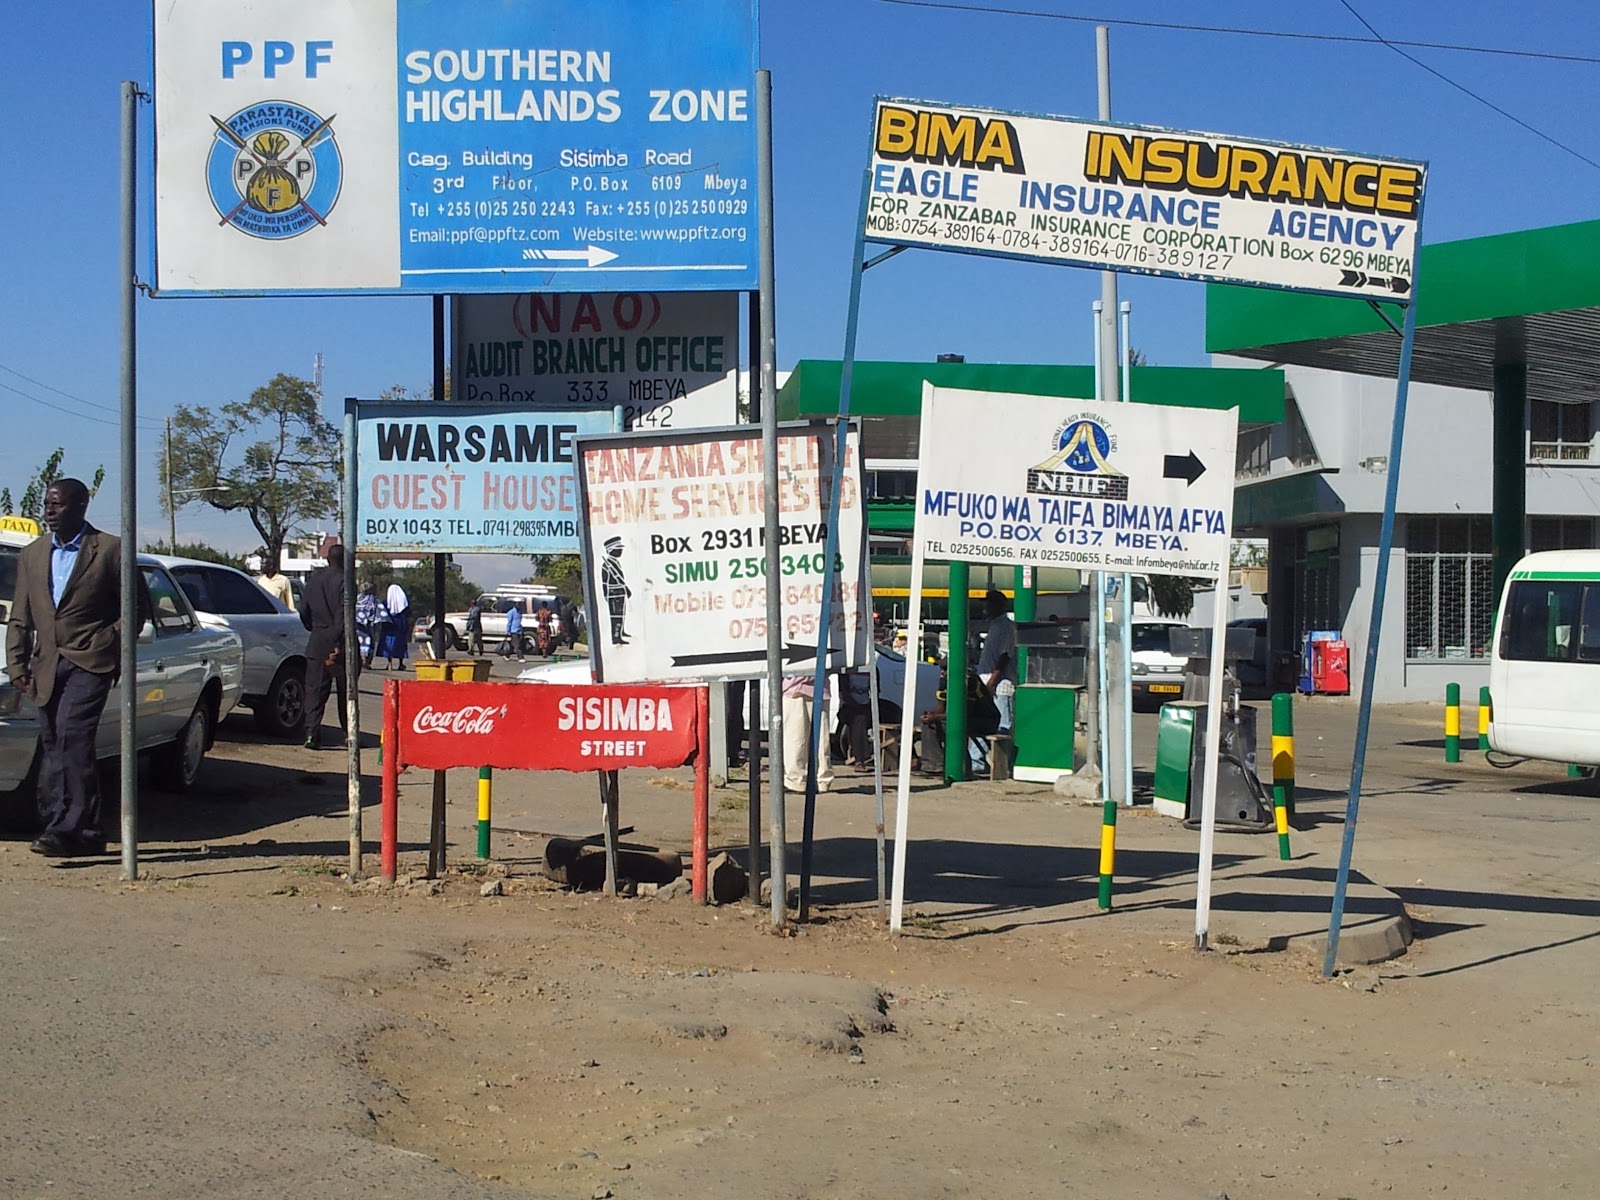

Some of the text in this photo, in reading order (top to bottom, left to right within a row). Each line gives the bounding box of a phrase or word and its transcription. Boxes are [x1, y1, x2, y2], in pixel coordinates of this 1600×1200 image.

[221, 40, 334, 79] PPF
[405, 49, 611, 83] SOUTHERN
[228, 106, 318, 131] PARASTATAL
[406, 89, 748, 123] HIGHLANDS ZONE
[237, 117, 311, 136] PENSIONS FUND
[462, 150, 534, 170] Building
[560, 149, 629, 168] Sisimba
[646, 148, 692, 166] Road
[876, 104, 1420, 220] BIMA INSURANCE
[433, 175, 465, 194] 3rd
[651, 175, 682, 191] 6109
[704, 174, 748, 196] Mbeya
[410, 202, 430, 217] Tel
[541, 200, 576, 217] 2243
[873, 163, 1405, 251] EAGLE INSURANCE AGENCY
[870, 196, 1412, 277] FOR ZANZABAR INSURANCE CORPORATION Box 6296 MBEYA
[465, 335, 724, 379] AUDIT BRANCH OFFICE
[567, 380, 608, 402] 333
[629, 377, 688, 401] MBEYA
[376, 422, 578, 463] WARSAME
[584, 442, 726, 485] TANZANIA
[730, 435, 825, 475] SHELD
[371, 471, 575, 512] GUEST HOUSE
[1035, 472, 1112, 494] NHIF
[587, 486, 667, 527] HOME
[923, 489, 998, 519] MFUKO
[1002, 496, 1032, 524] WA
[1038, 498, 1096, 529] TAIFA
[1178, 508, 1227, 535] AFYA
[2, 518, 32, 533] TAXI
[366, 518, 399, 535] BOX
[403, 518, 442, 535] 1043
[651, 522, 828, 555] Box 2931 BEYA
[1019, 547, 1038, 561] FAX
[664, 559, 719, 583] SIMU
[654, 589, 724, 615] Mobile
[411, 696, 673, 734] Coca-Cola SISIMBA
[580, 739, 647, 757] STREET
